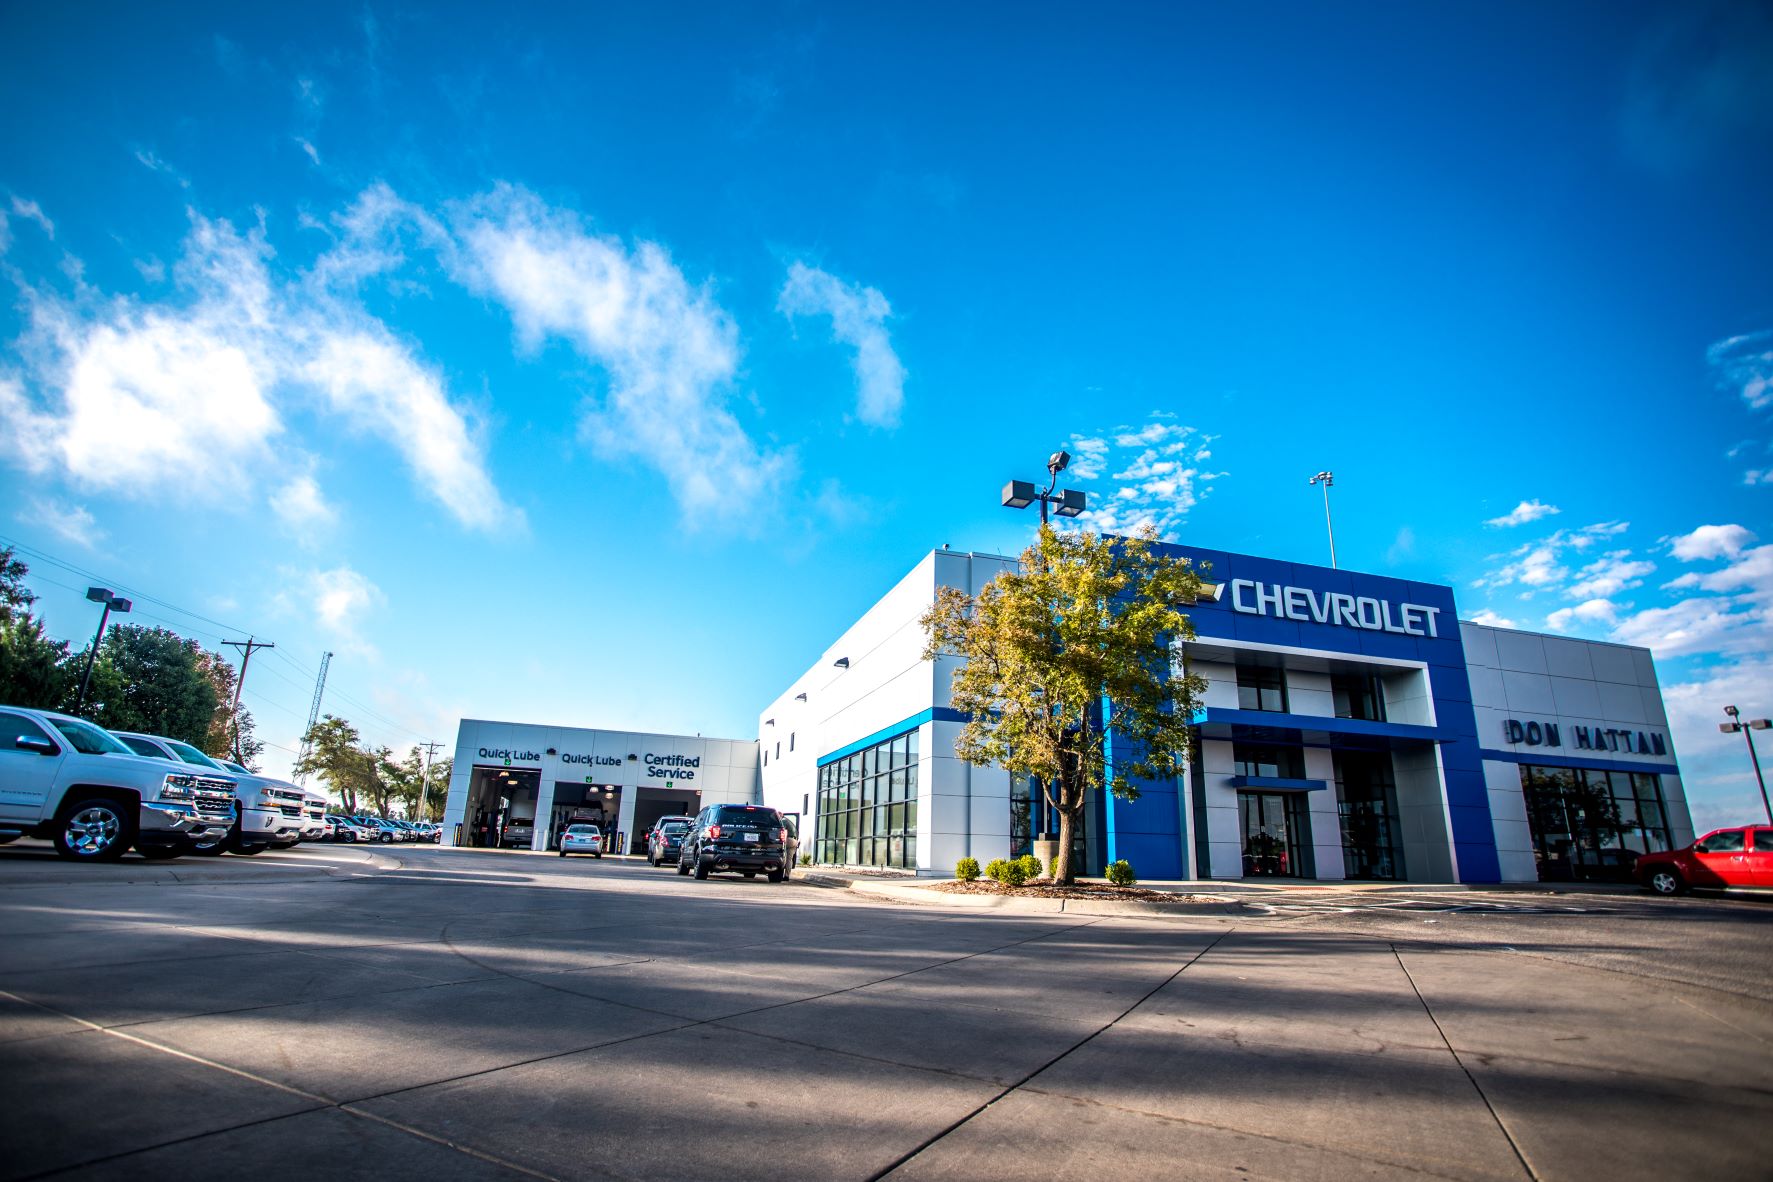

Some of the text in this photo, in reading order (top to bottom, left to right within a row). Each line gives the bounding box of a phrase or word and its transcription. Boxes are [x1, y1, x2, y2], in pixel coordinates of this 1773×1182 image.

[1231, 578, 1440, 637] CHEVROLET
[1504, 719, 1667, 756] DON HATTAN
[479, 747, 540, 761] Quick Lube
[562, 753, 622, 767] Quick Lube
[644, 753, 700, 768] Certified
[647, 766, 695, 780] Service
